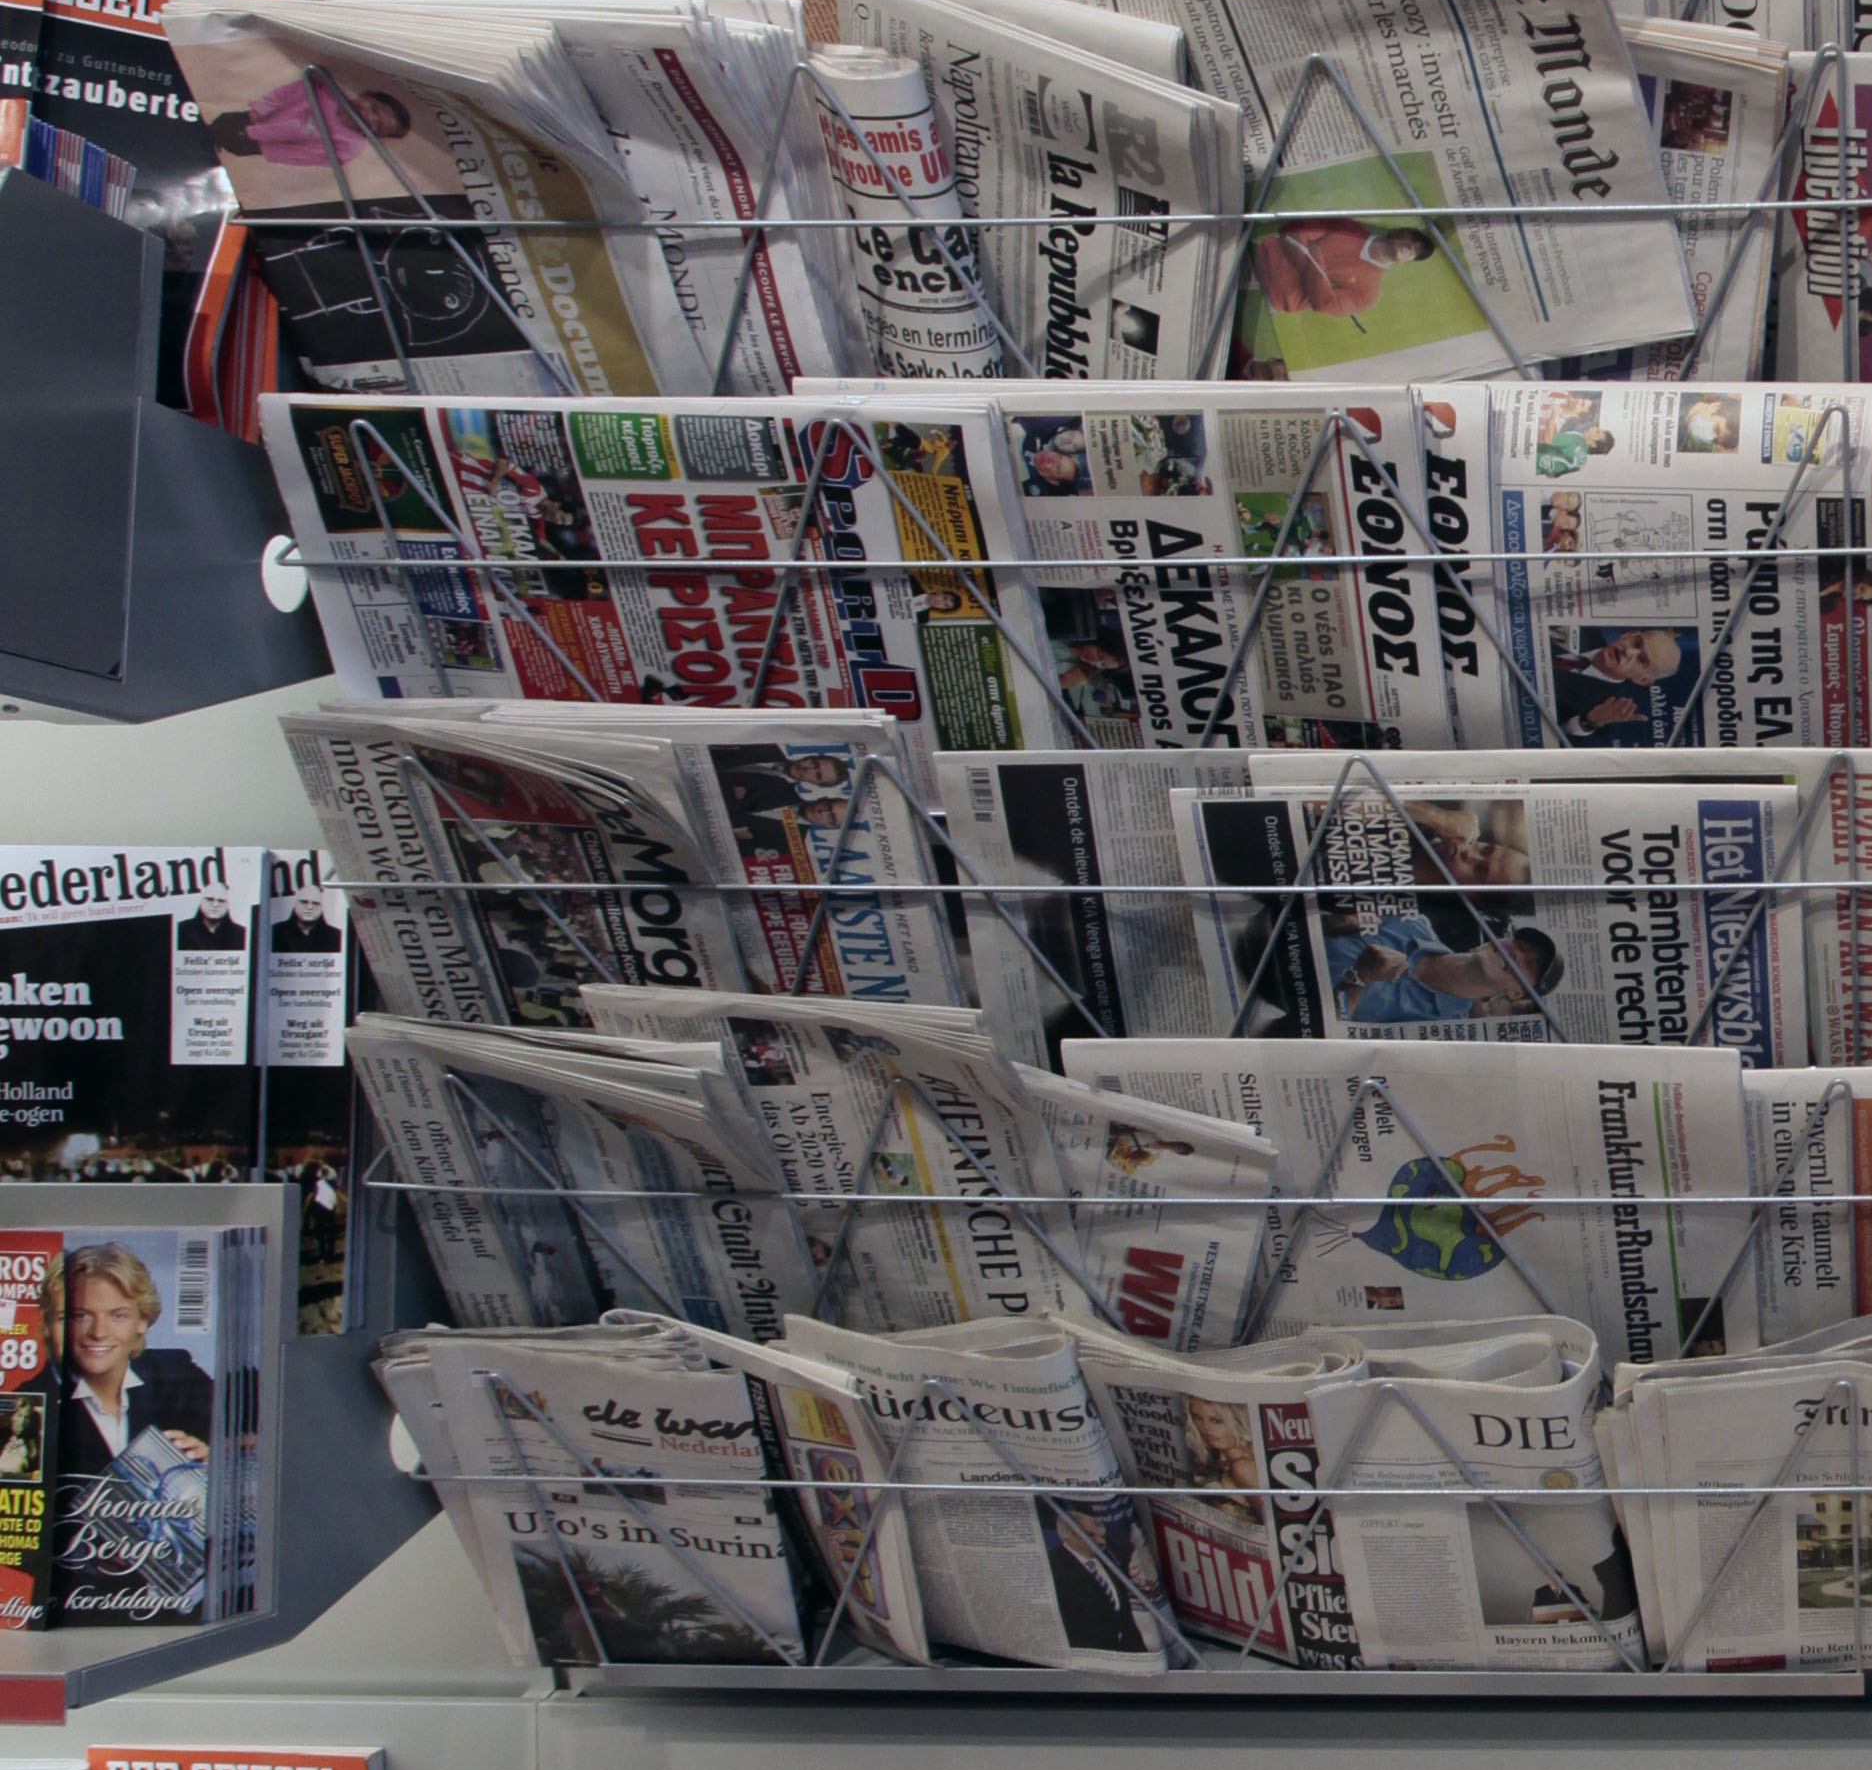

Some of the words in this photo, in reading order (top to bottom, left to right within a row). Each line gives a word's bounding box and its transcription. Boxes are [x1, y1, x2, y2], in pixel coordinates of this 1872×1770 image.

[1518, 12, 1621, 201] Monde
[1472, 1412, 1577, 1451] DIE
[56, 1473, 199, 1519] Thomas
[55, 1521, 172, 1575] Berge
[64, 1585, 192, 1621] kerstdagen
[1171, 1532, 1275, 1632] Bild
